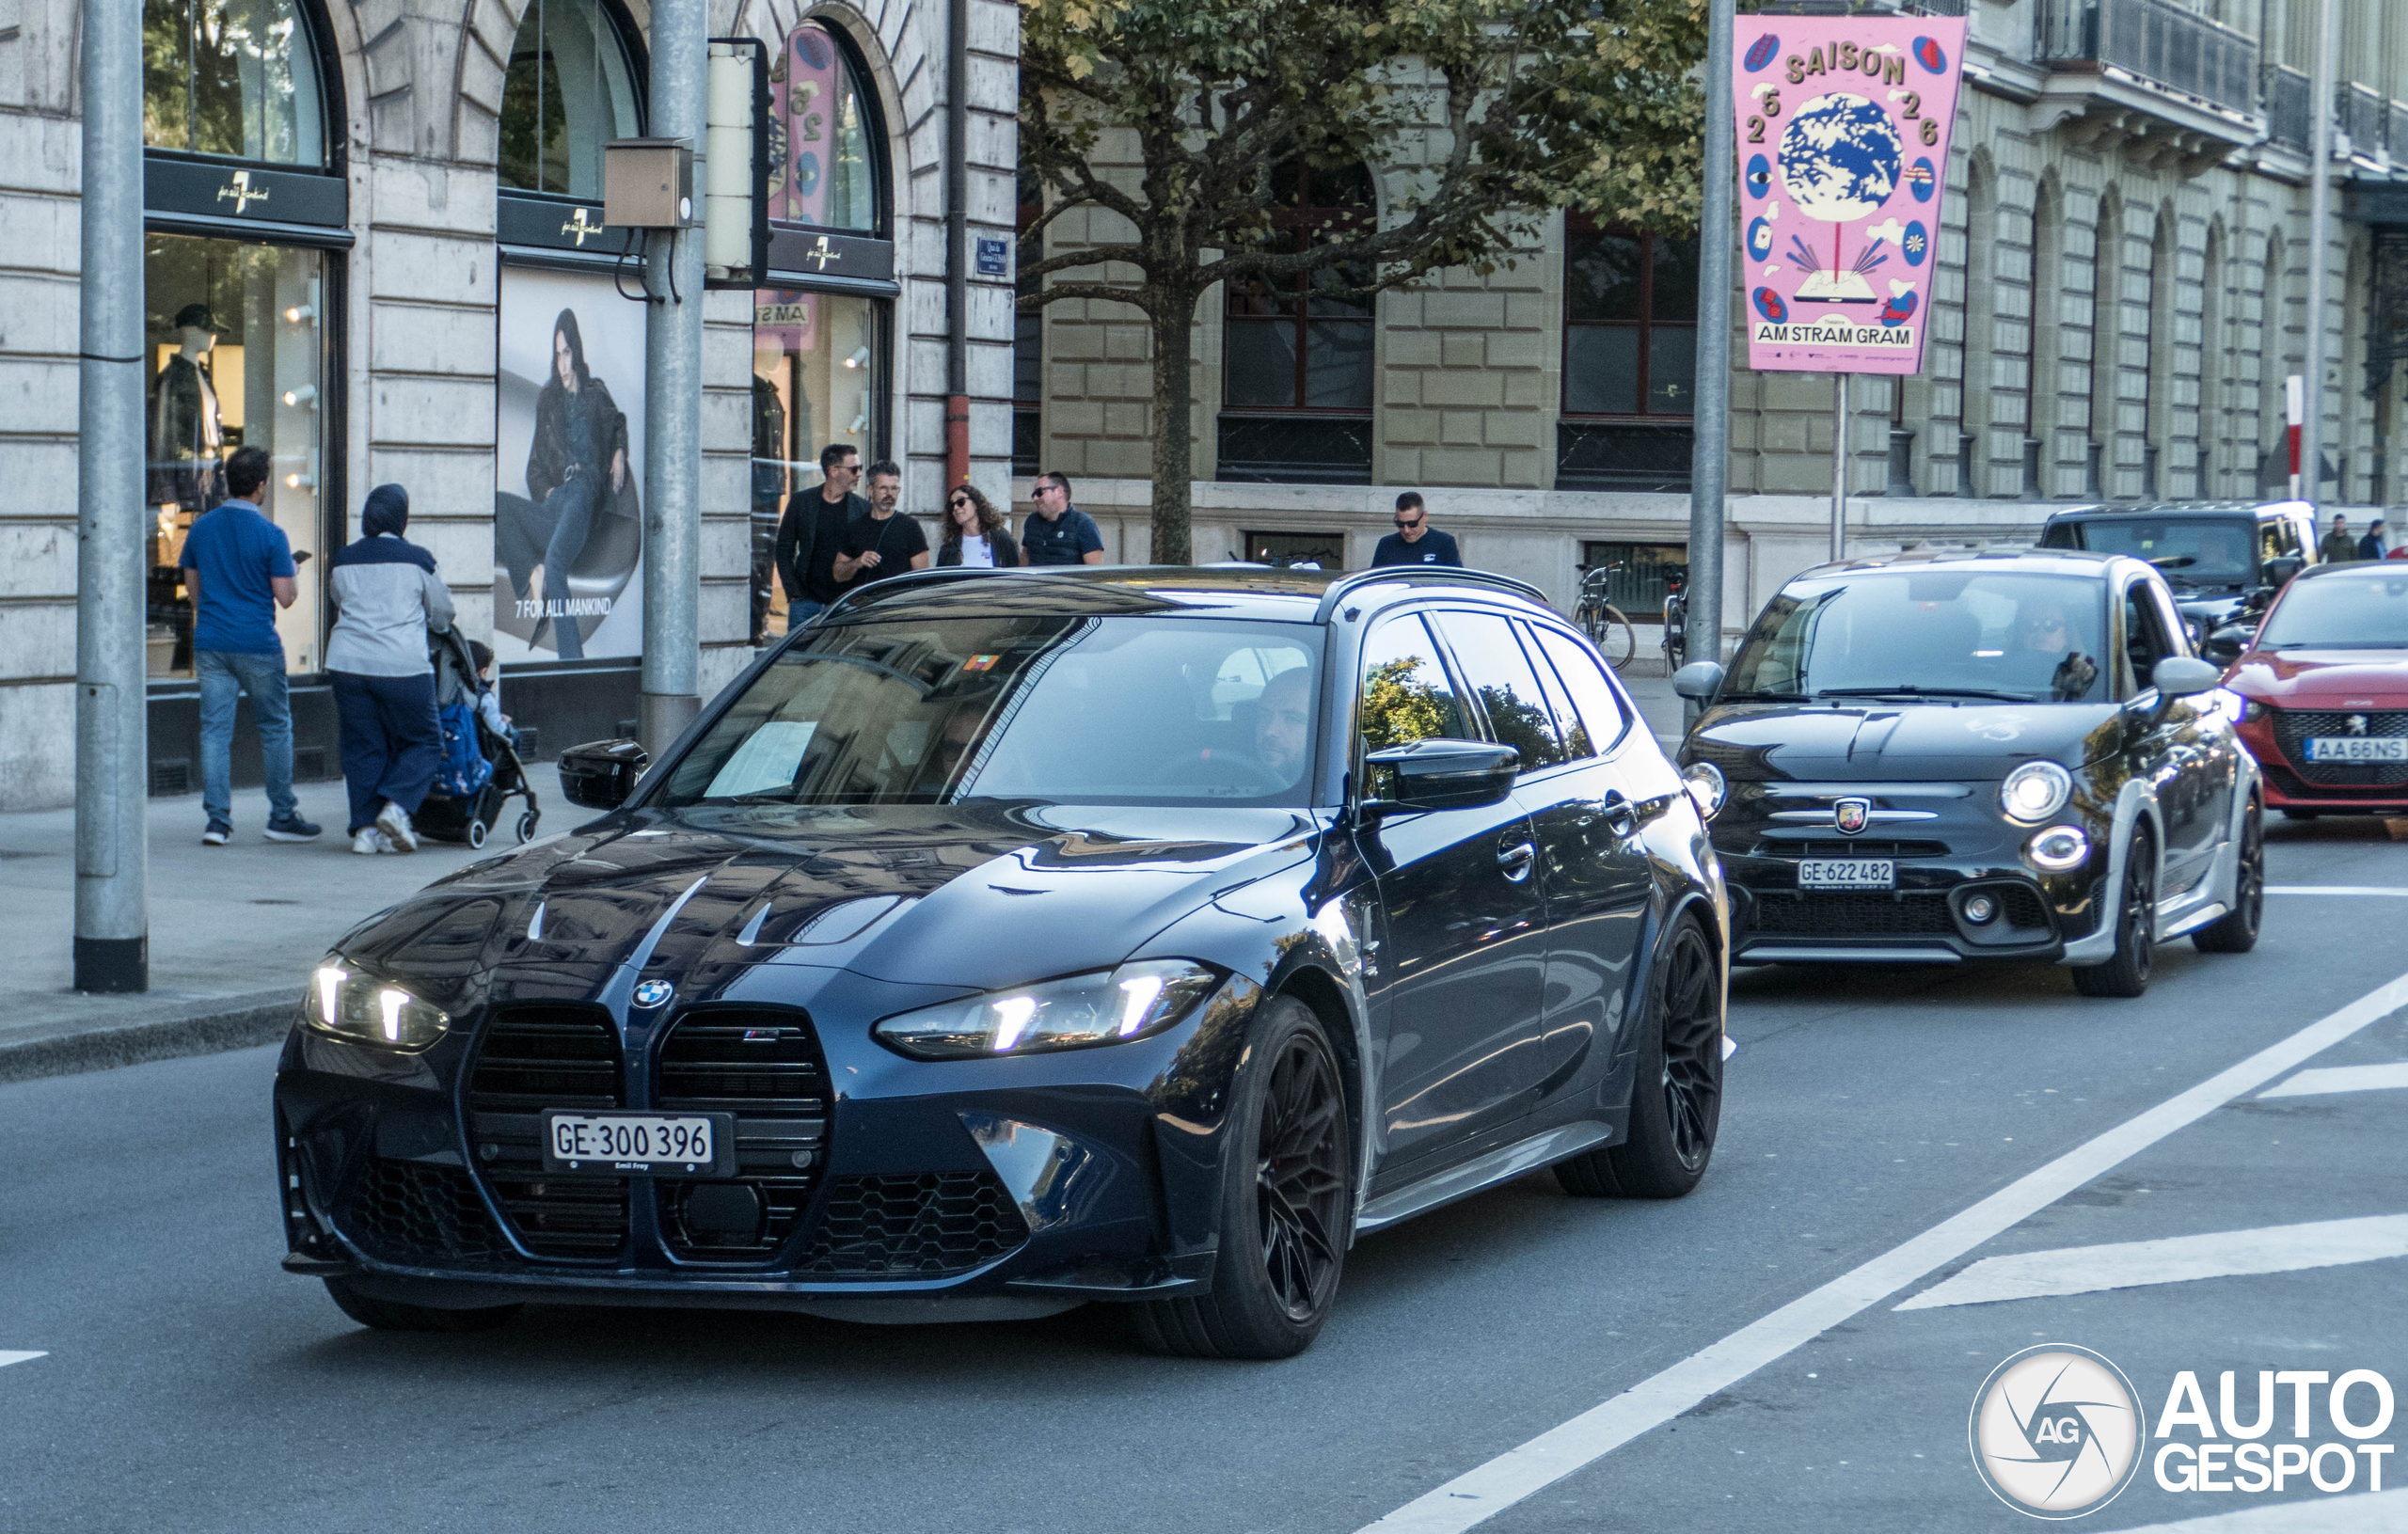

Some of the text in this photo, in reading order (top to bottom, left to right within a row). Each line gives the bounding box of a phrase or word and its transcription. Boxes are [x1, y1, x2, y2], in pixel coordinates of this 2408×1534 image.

[1786, 40, 1905, 85] SAISON
[1758, 325, 1909, 344] AM STRAM GRAM
[515, 597, 611, 619] 7 FOR ALL MANKIND
[1860, 862, 1891, 880] 482
[656, 1125, 706, 1158] 396
[632, 1162, 649, 1171] Frey
